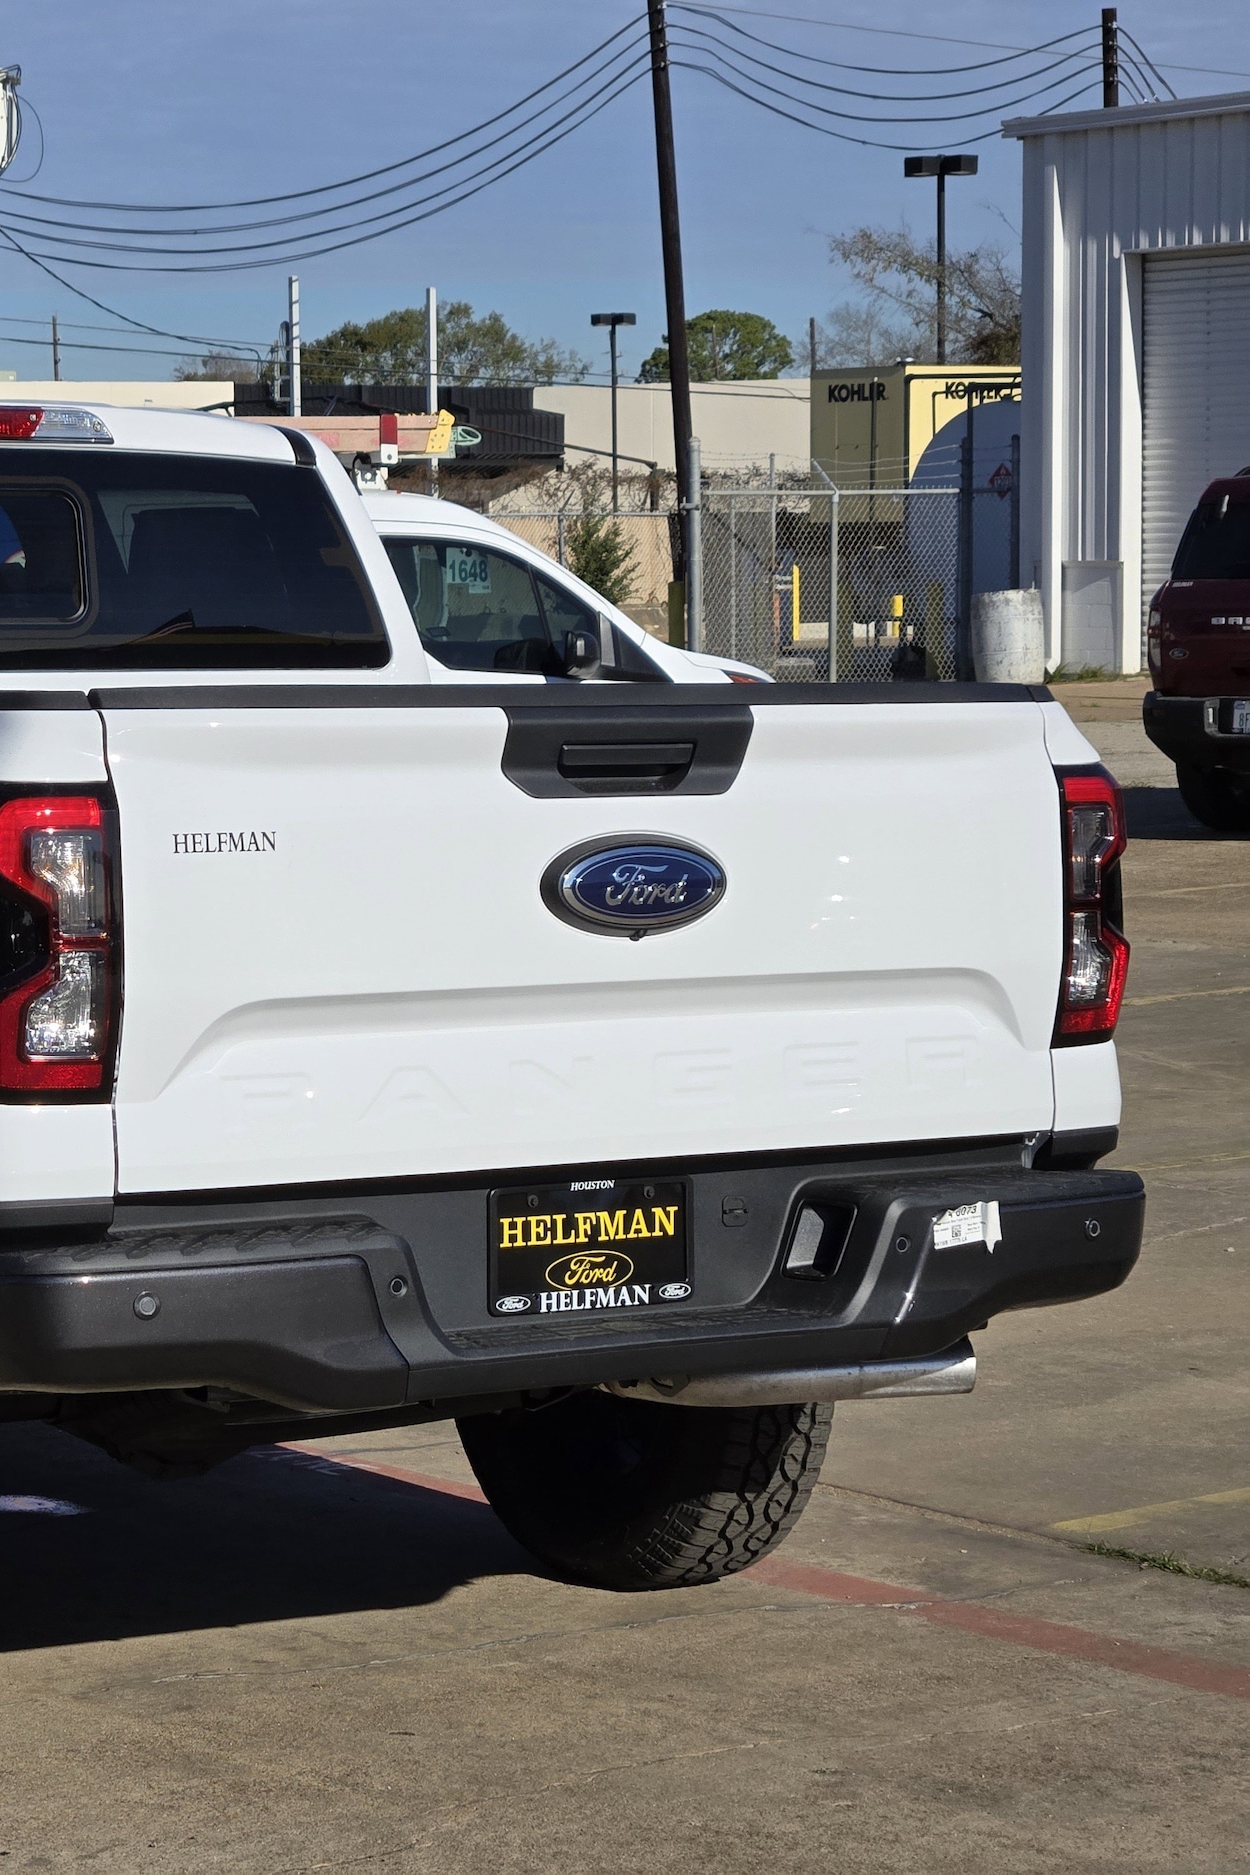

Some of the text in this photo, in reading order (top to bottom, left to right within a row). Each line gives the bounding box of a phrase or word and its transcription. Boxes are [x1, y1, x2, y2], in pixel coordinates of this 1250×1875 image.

[449, 559, 488, 582] 1648
[172, 831, 277, 854] HELFMAN
[605, 863, 688, 906] Ford
[218, 1036, 987, 1131] RANGER
[570, 1180, 615, 1191] HOUSTON
[500, 1206, 678, 1248] HELFMAN
[564, 1255, 618, 1285] Ford
[502, 1284, 686, 1313] Ford HELFMAN Ford
